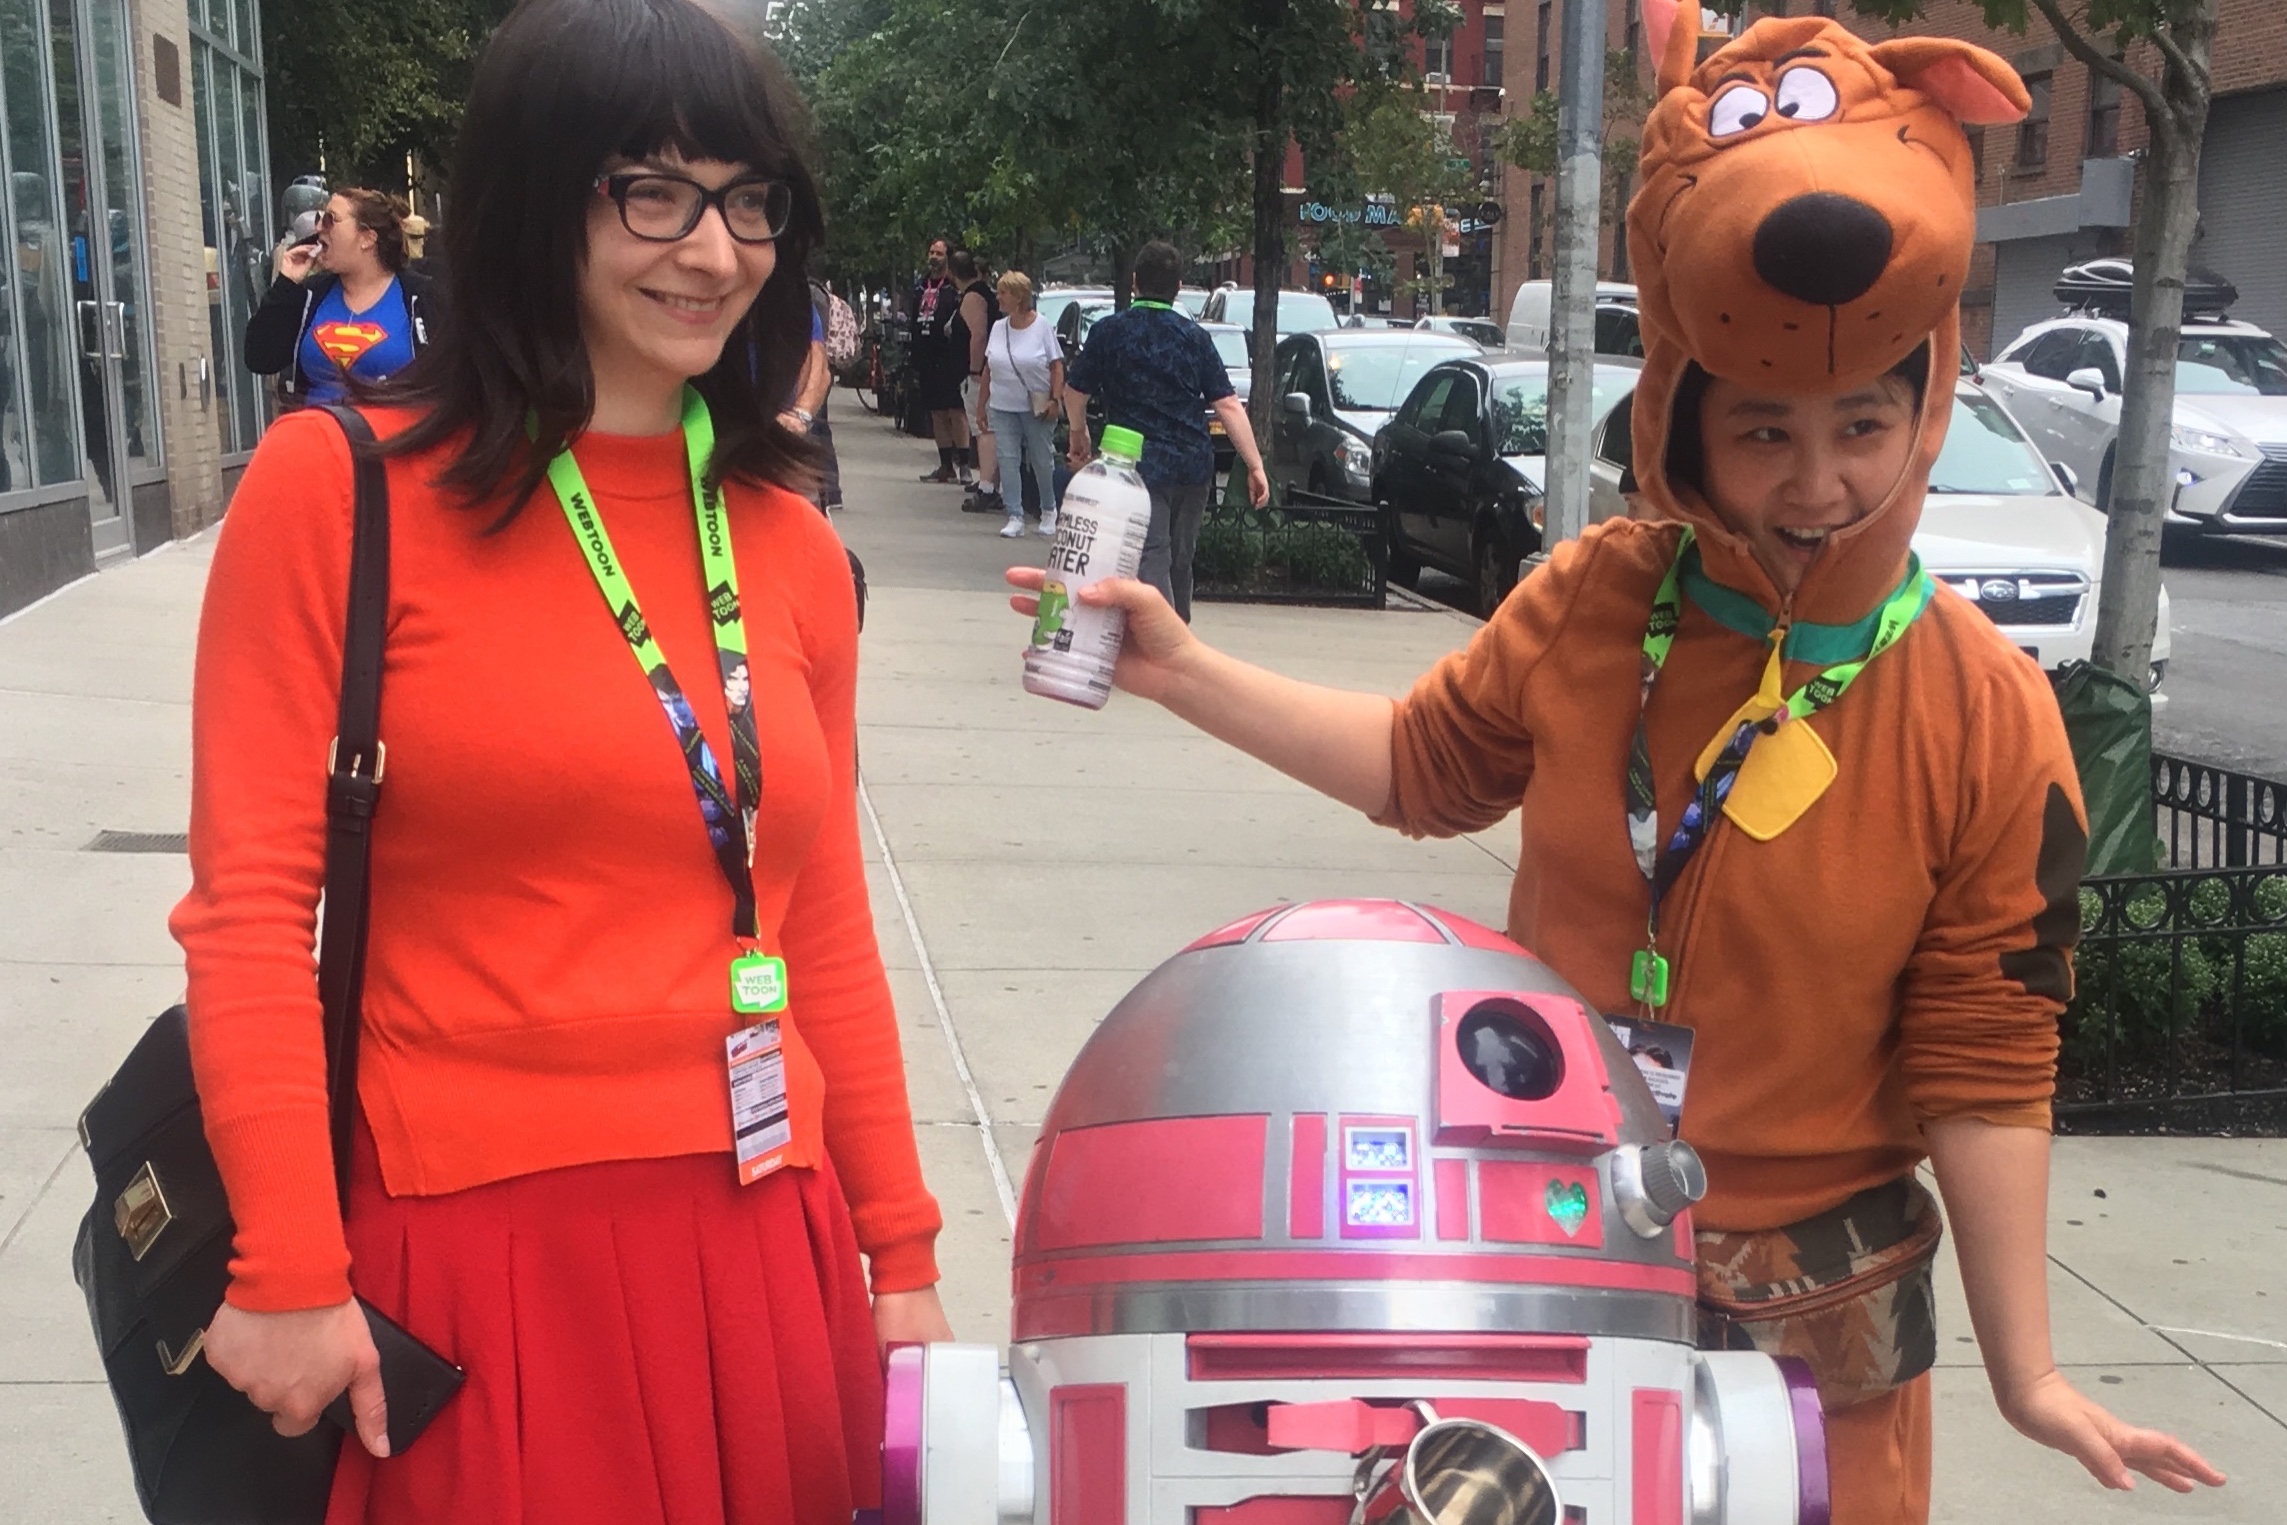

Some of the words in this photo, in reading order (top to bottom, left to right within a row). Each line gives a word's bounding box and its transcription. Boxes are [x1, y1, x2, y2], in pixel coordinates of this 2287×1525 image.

[1058, 512, 1099, 535] RMLESS
[571, 492, 616, 577] WEBTOON
[1055, 528, 1097, 553] CONUT
[1047, 546, 1090, 577] ATER
[711, 592, 733, 608] WEB
[623, 611, 640, 632] WEB
[1813, 680, 1836, 697] WEB
[744, 974, 772, 985] WEB
[741, 985, 777, 996] TOON
